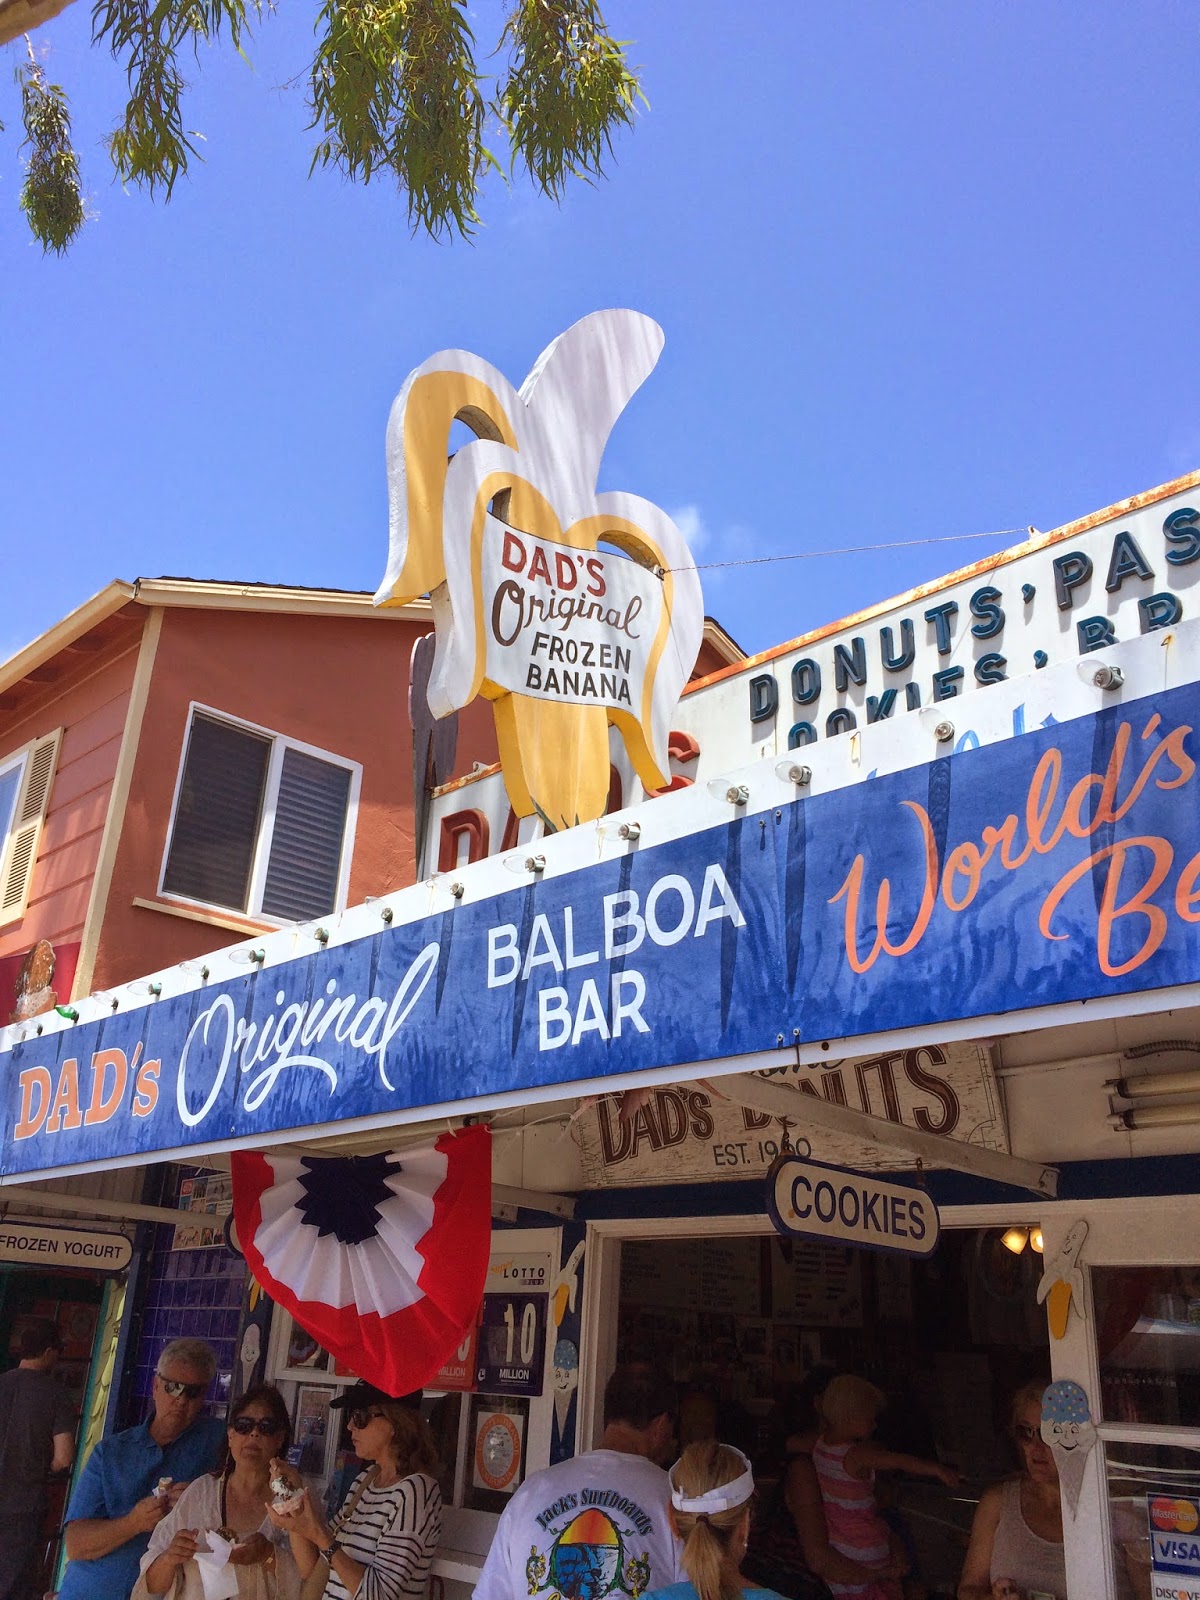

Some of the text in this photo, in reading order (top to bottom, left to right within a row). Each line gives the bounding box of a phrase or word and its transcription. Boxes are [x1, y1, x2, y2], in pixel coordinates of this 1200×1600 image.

[501, 531, 607, 597] DAD'S
[491, 580, 642, 647] Original
[531, 631, 632, 674] FROZEN
[525, 663, 633, 706] BANANA
[828, 713, 1196, 974] World's
[487, 863, 747, 989] BALBOA
[176, 941, 440, 1127] Original
[538, 969, 651, 1052] BAR
[713, 1143, 752, 1166] EST.
[791, 1175, 927, 1240] COOKIES
[0, 1235, 123, 1258] FROZEN YOGURT
[503, 1267, 545, 1278] LOTTO
[504, 1302, 537, 1364] 10
[499, 1368, 530, 1380] MILLION
[534, 1488, 654, 1536] Jack's Surfboards
[1152, 1508, 1198, 1522] MasterCard
[1158, 1540, 1200, 1561] VISA
